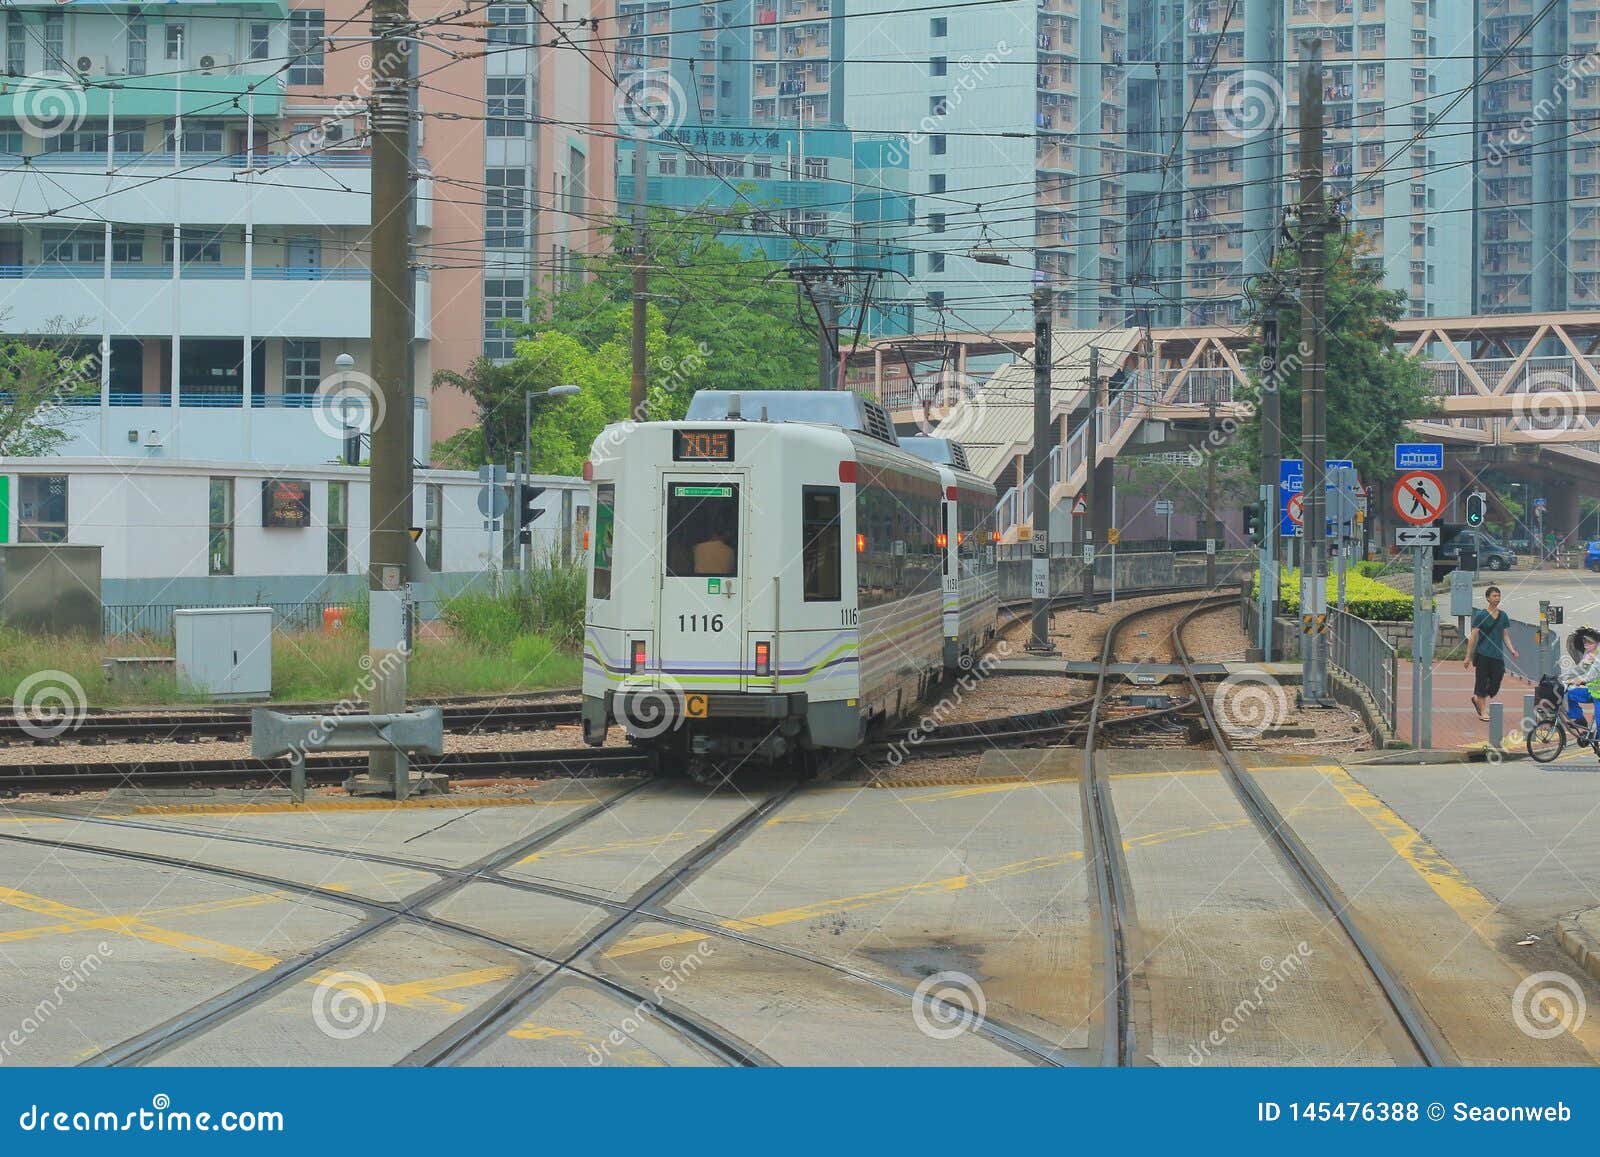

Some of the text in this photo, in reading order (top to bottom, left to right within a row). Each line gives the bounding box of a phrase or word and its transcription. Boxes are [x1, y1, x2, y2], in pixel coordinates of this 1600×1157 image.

[681, 433, 728, 457] 705
[678, 614, 724, 632] 1116
[840, 607, 858, 626] 1116
[686, 695, 705, 716] C
